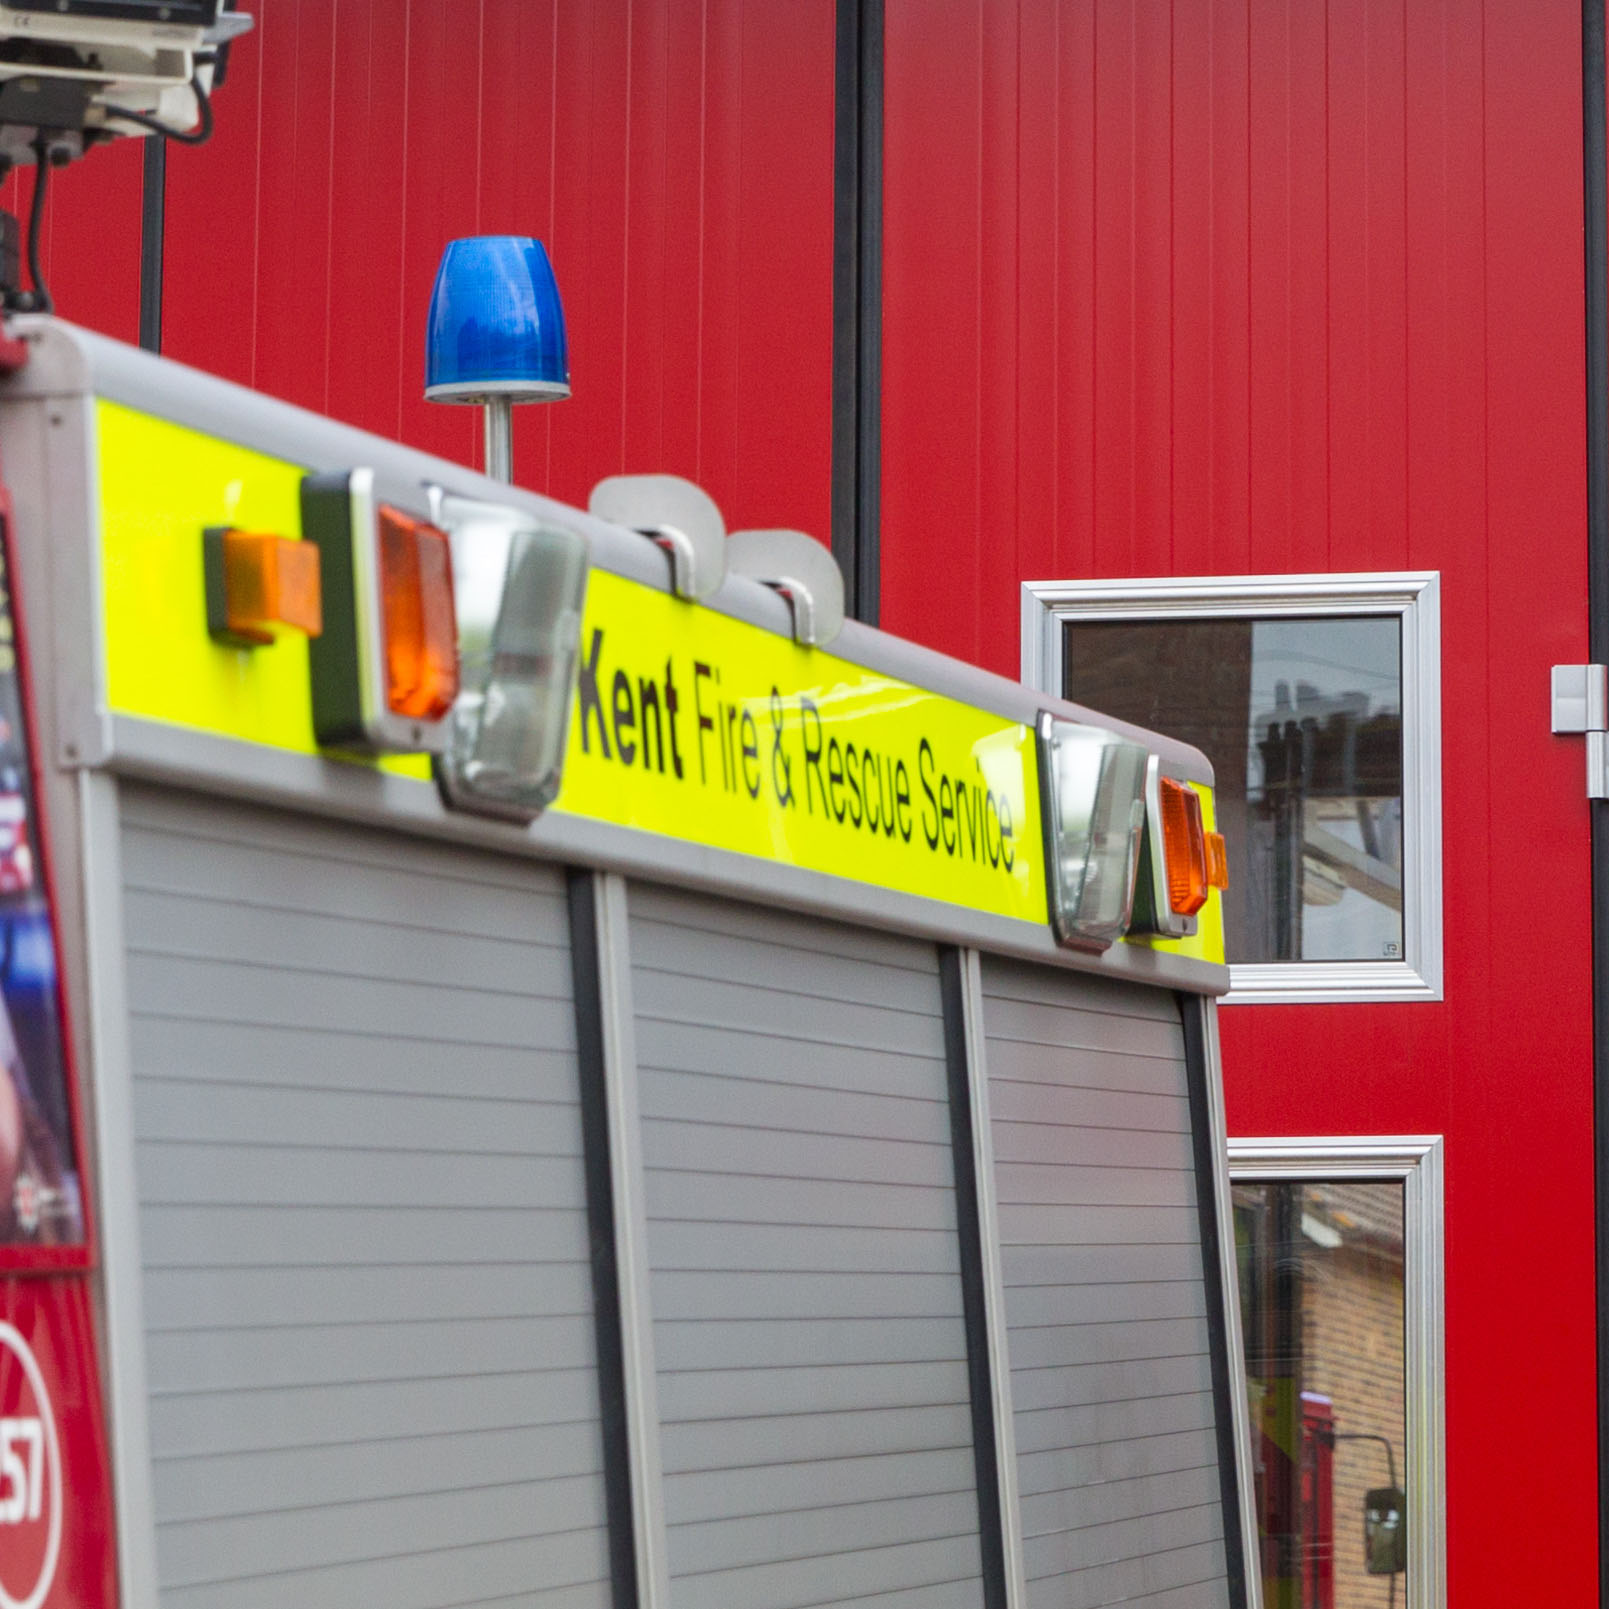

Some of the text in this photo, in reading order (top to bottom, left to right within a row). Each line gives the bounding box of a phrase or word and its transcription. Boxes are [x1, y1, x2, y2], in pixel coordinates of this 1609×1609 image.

[577, 627, 1015, 874] Kent Fire & Rescue Service
